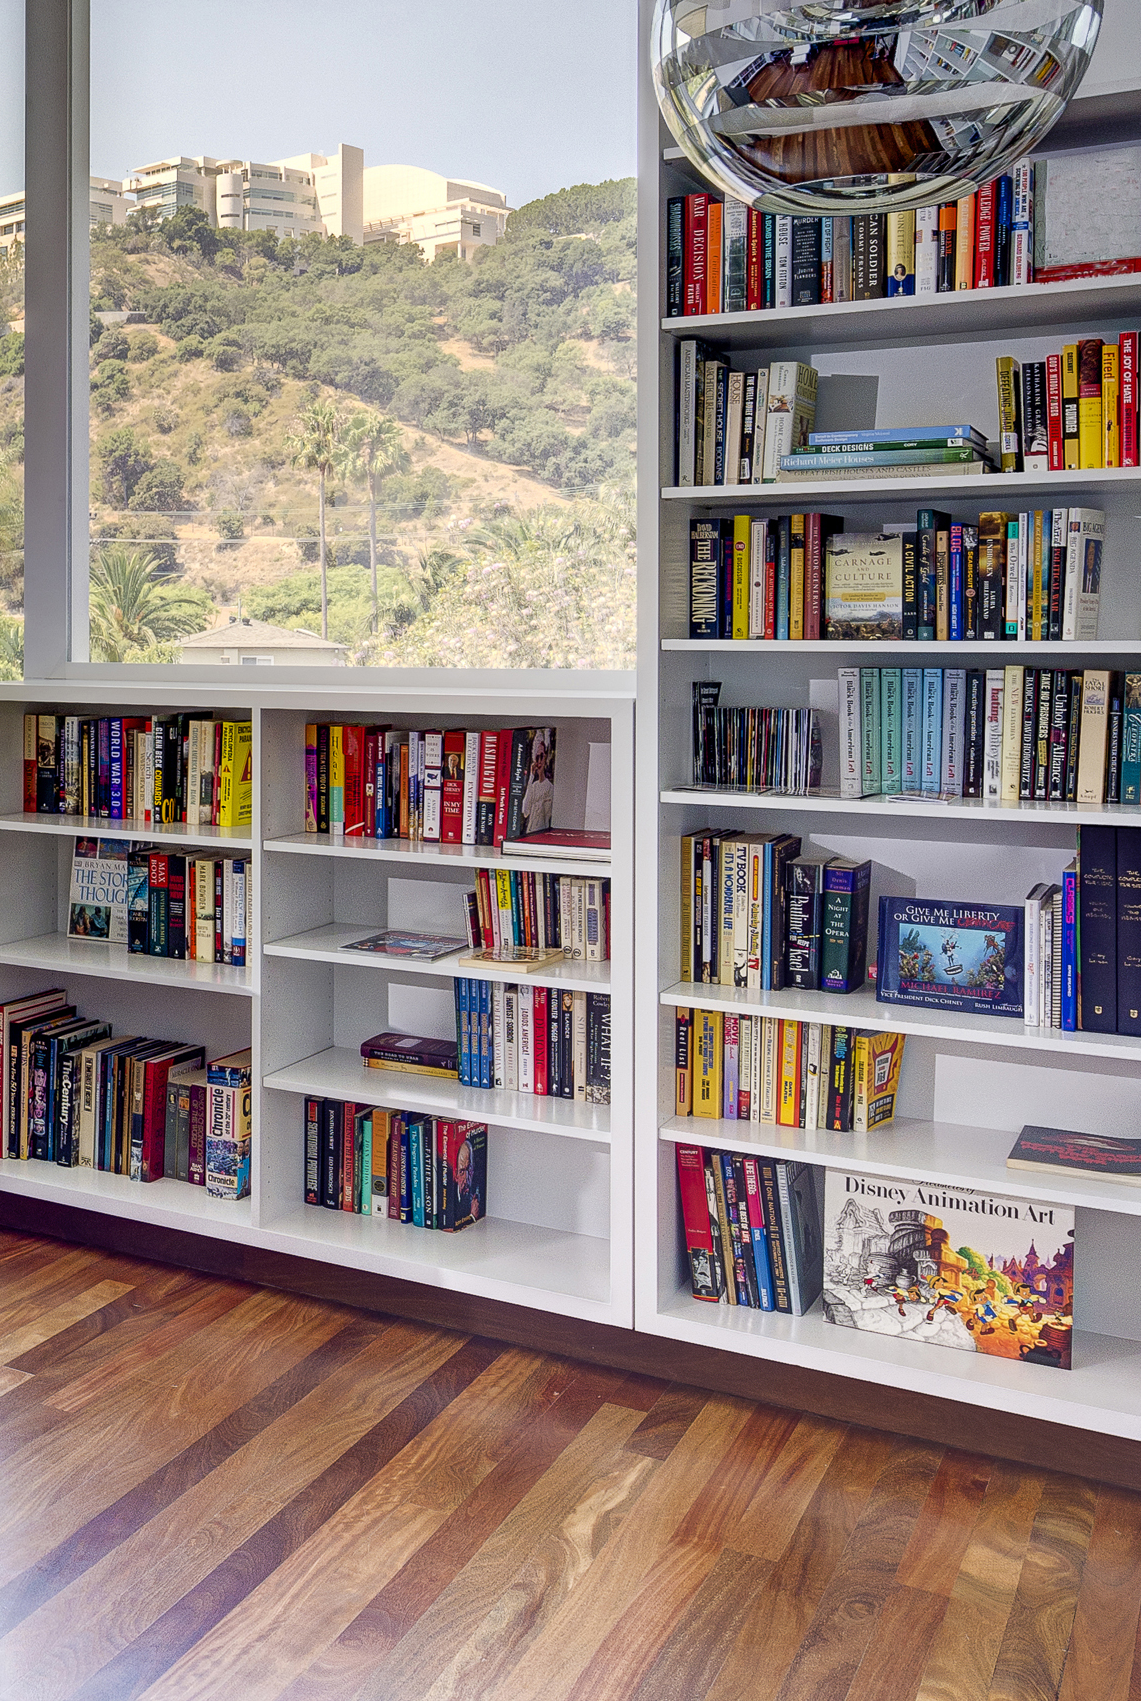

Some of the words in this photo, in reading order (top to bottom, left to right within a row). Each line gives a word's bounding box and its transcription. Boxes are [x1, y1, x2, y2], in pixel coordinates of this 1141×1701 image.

[694, 197, 705, 217] WAR
[779, 223, 788, 246] HOUSE
[693, 230, 705, 280] DECISION
[869, 239, 878, 287] SOLDIER
[1123, 355, 1132, 370] JOY
[1123, 372, 1132, 383] OF
[1123, 385, 1132, 404] HATE
[1065, 404, 1077, 433] PLUNDER
[842, 444, 874, 452] DESIGNS
[784, 457, 816, 467] Richard
[819, 456, 842, 465] Meier
[844, 455, 875, 463] Houses
[697, 524, 712, 532] DAVID
[951, 526, 962, 552] BLOG
[697, 540, 711, 560] THE
[834, 558, 892, 566] CARNAGE
[905, 551, 914, 572] CIVIL
[835, 573, 892, 581] CULTURE
[692, 560, 717, 623] RECKONING
[905, 575, 915, 602] ACTION
[1041, 673, 1051, 690] TAKE
[1025, 677, 1033, 712] RADICALS
[1041, 692, 1050, 700] NO
[1039, 702, 1049, 739] PRISONERS
[1051, 694, 1067, 728] Unholy
[111, 722, 120, 758] WORLD
[1024, 721, 1032, 743] DAVID
[155, 751, 163, 768] BECK
[483, 736, 497, 794] WASHINGTON
[1022, 744, 1032, 782] HOROWITZ
[1052, 743, 1065, 783] Alliance
[111, 762, 121, 785] WAR
[154, 770, 162, 806] COWARDS
[737, 847, 747, 860] TV
[75, 869, 99, 885] THE
[737, 863, 746, 894] BOOK
[79, 886, 128, 905] THOUG
[828, 904, 849, 912] NIGHT
[906, 906, 930, 916] GIVE
[934, 909, 949, 917] ME
[954, 910, 1000, 921] LIBERTY
[724, 917, 733, 930] LIFE
[894, 913, 908, 921] OR
[912, 915, 935, 923] GIVE
[939, 917, 954, 925] ME
[825, 928, 849, 937] OPERA
[901, 981, 947, 993] MICHAEL
[953, 987, 1001, 999] RAMIREZ
[536, 1018, 544, 1066] DEMONIC
[601, 1013, 611, 1051] WHAT
[679, 1026, 687, 1044] Reel
[731, 1018, 739, 1046] MOVIE
[212, 1088, 224, 1136] Chronicle
[845, 1177, 907, 1205] Disney
[913, 1188, 1019, 1219] Animation
[1023, 1205, 1056, 1225] Art
